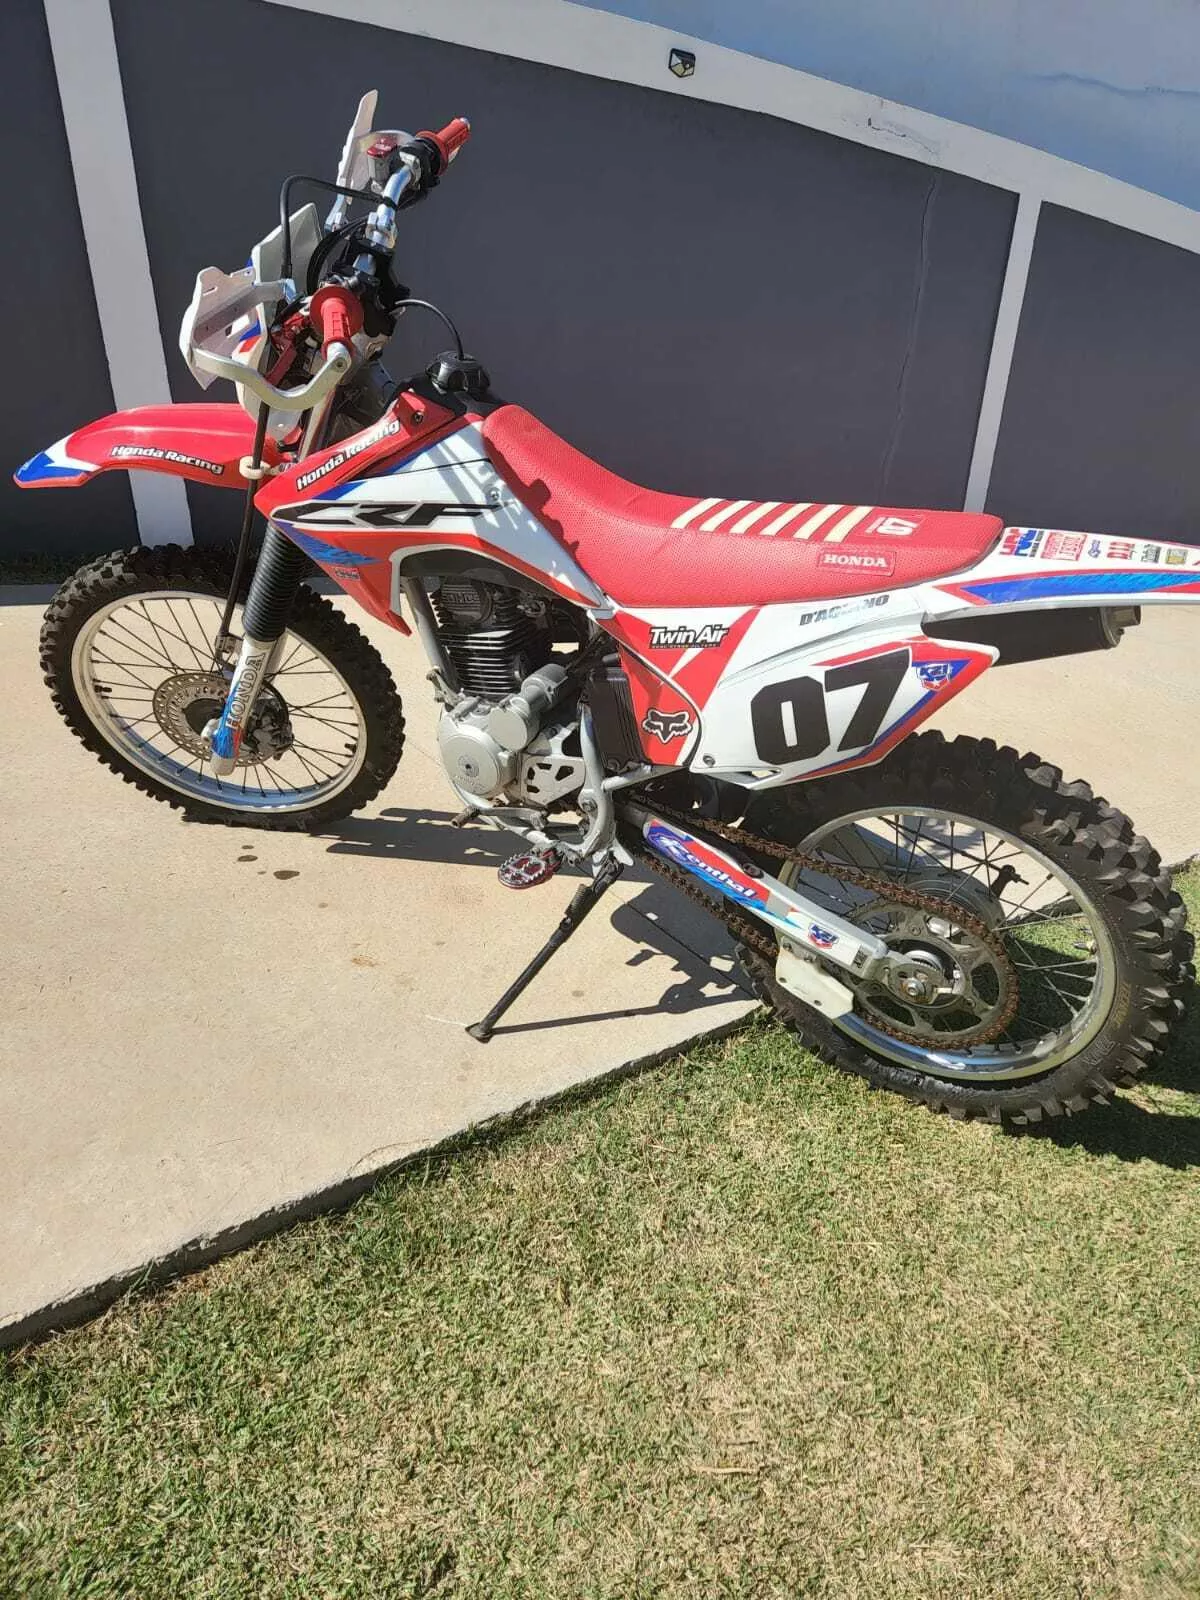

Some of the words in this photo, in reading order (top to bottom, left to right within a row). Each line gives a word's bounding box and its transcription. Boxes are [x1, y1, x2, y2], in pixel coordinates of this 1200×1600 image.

[111, 446, 164, 459] Honda
[164, 451, 224, 475] Racing
[296, 453, 345, 491] Honda
[823, 554, 888, 568] HONDA
[649, 626, 697, 646] Twin
[695, 624, 730, 644] Air
[225, 652, 267, 730] HONDA
[750, 646, 911, 766] 07
[656, 836, 758, 896] Renthal
